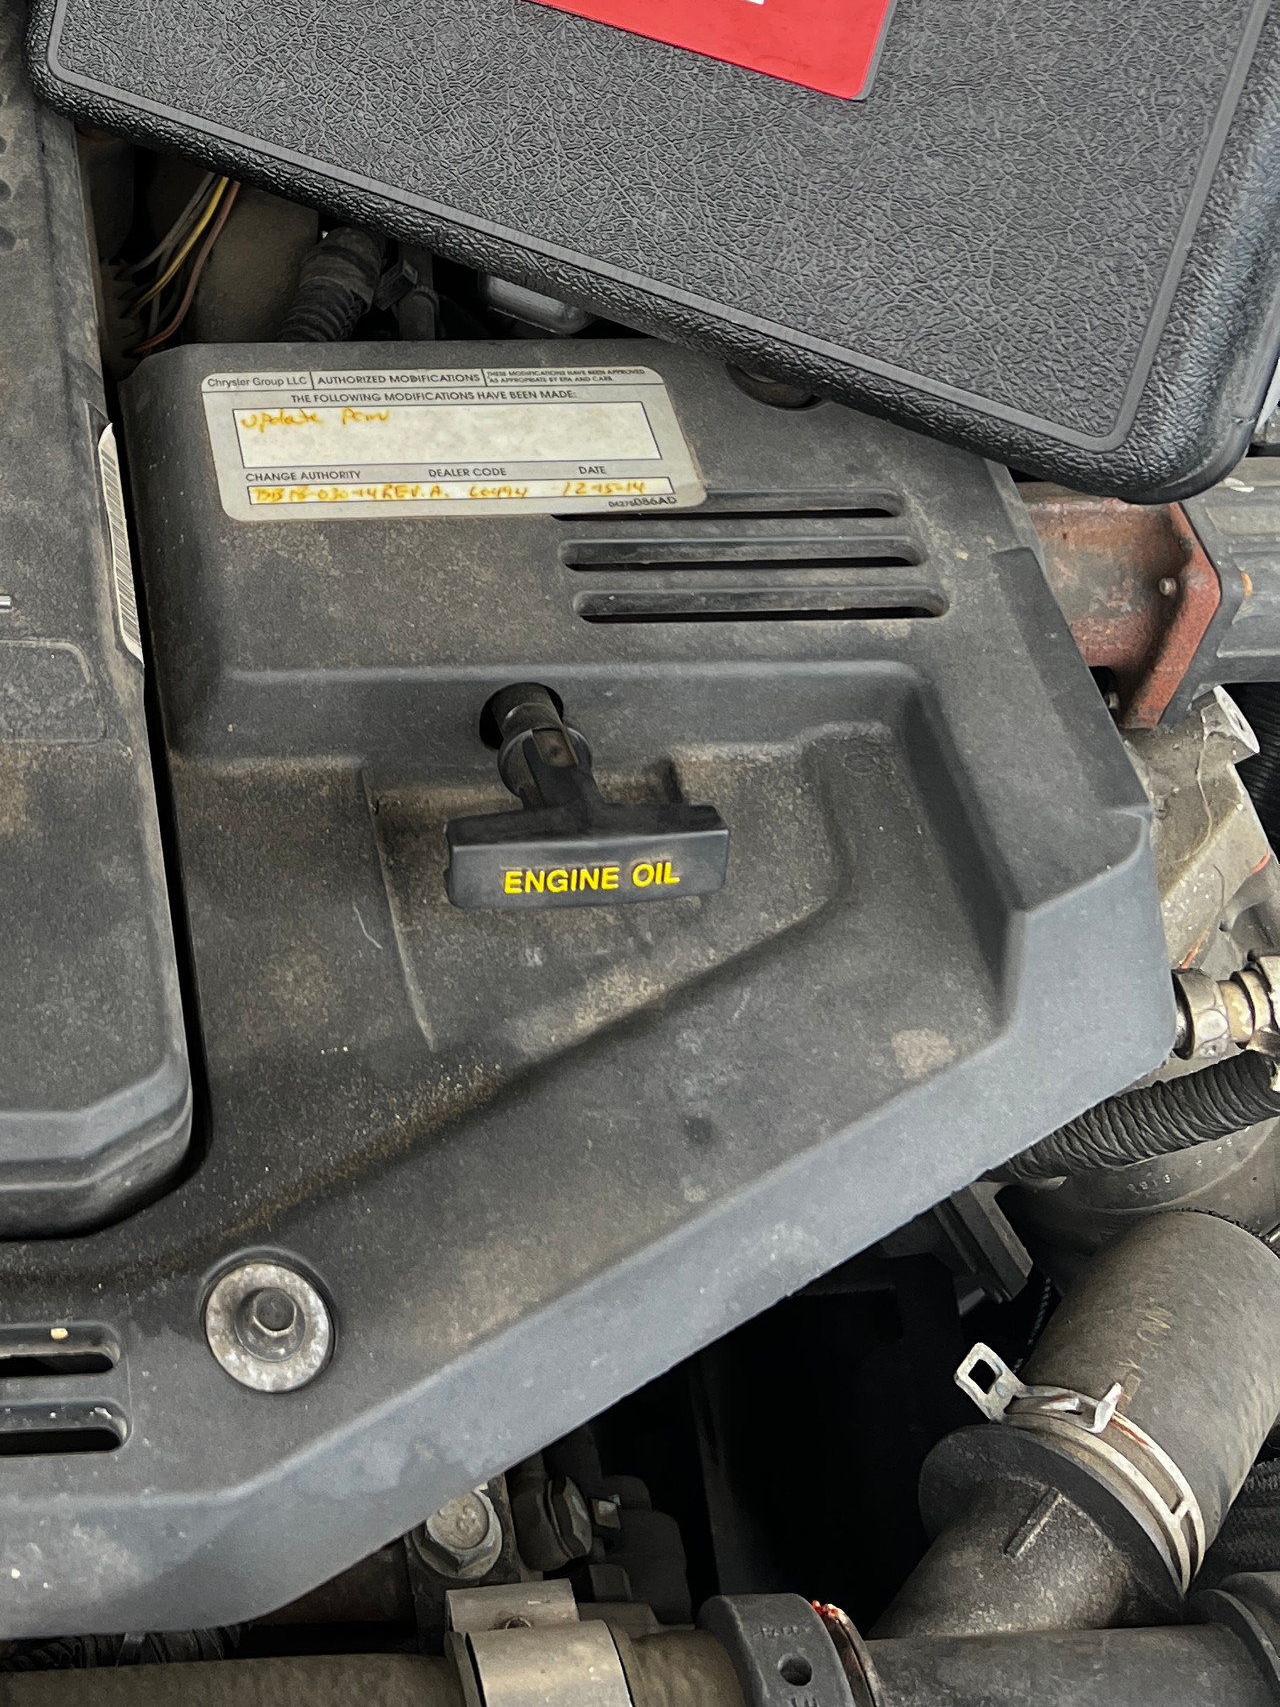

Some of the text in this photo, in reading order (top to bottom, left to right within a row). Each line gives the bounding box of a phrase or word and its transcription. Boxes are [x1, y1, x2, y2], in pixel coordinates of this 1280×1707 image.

[207, 375, 308, 388] Chrysler Group LLC
[317, 372, 481, 386] AUTHORIZED MODIFICATIONS
[291, 388, 578, 404] THE FOLLOWING MODIFICATIONS HAVE BEEN MADE:
[245, 470, 361, 482] CHANGE AUTHORITY
[428, 467, 508, 478] DEALER CODE
[578, 465, 607, 475] DATE
[504, 861, 681, 895] ENGINE OIL
